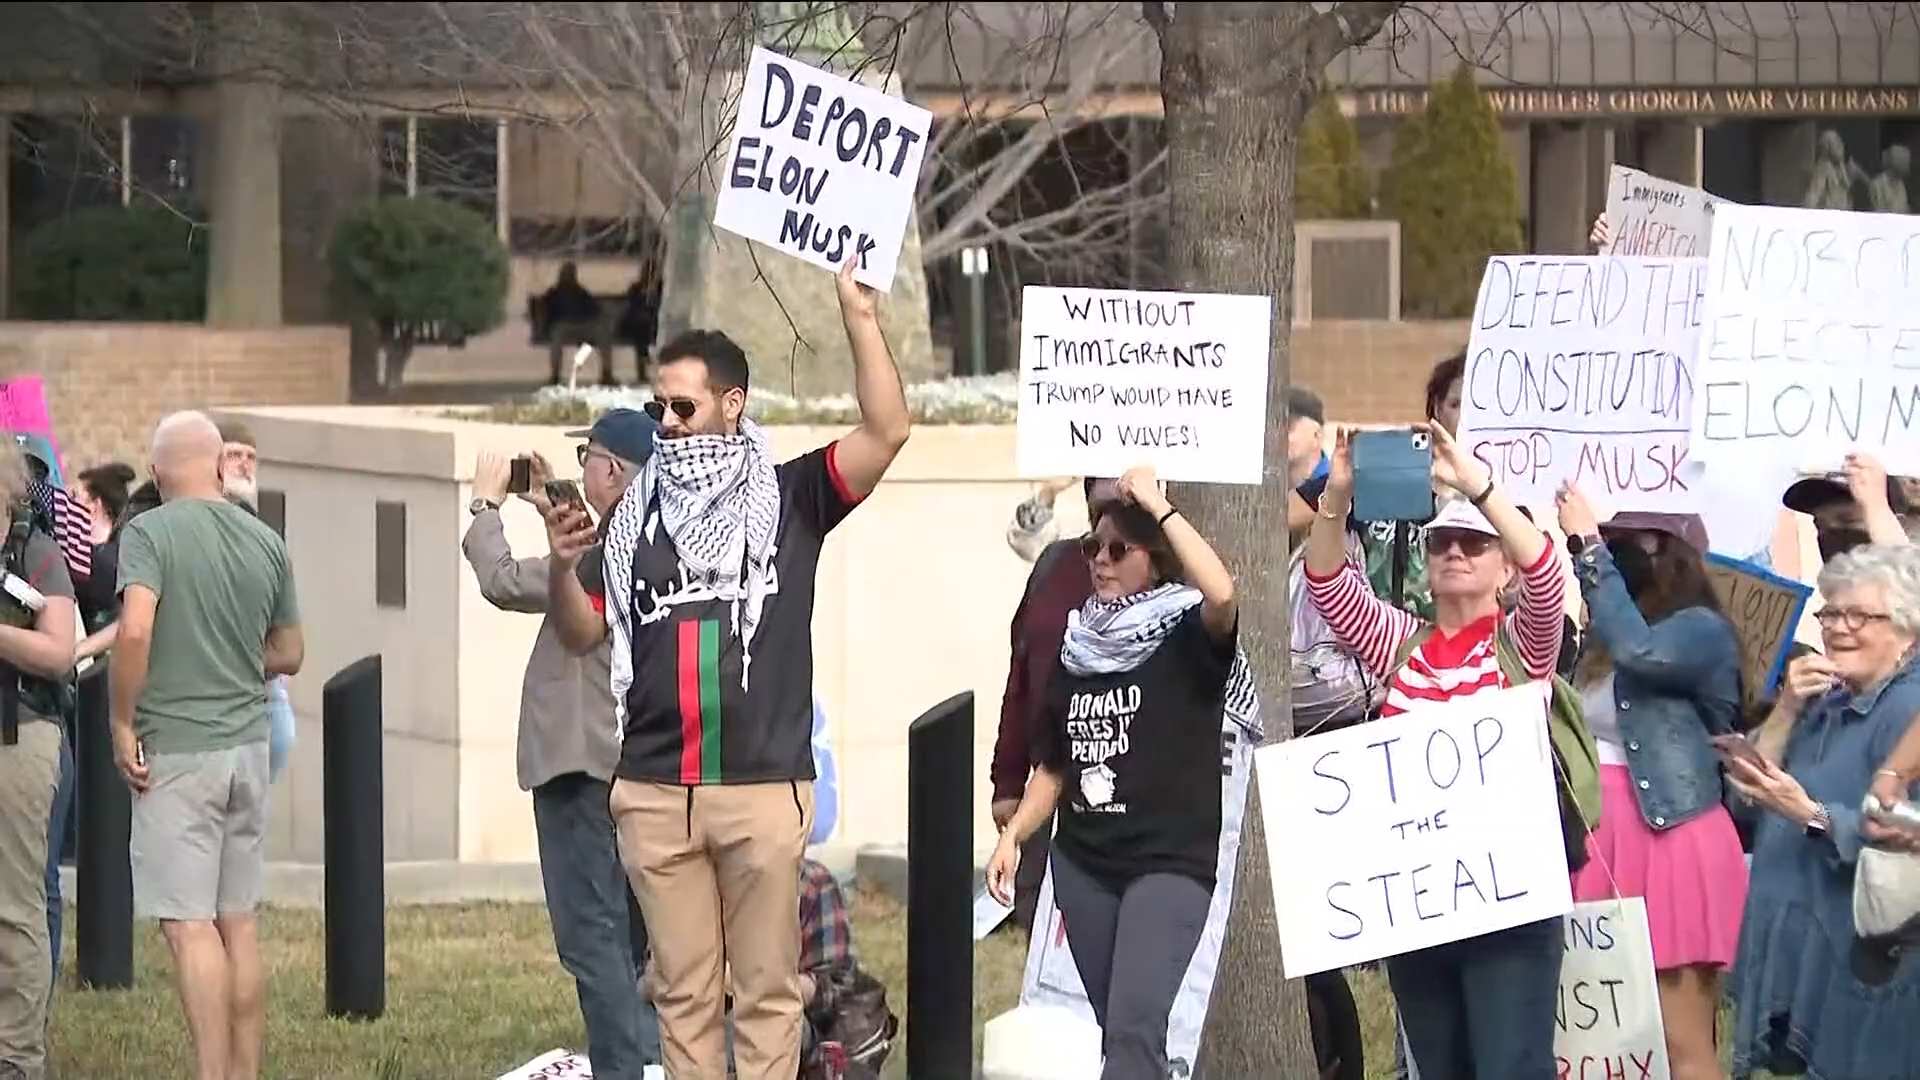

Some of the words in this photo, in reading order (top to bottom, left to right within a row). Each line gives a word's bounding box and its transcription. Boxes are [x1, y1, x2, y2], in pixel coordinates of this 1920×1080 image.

[760, 63, 920, 178] DEPORT
[1726, 89, 1774, 112] WAR
[1784, 89, 1908, 112] VETERANS
[731, 136, 829, 205] ELON
[779, 209, 876, 270] MUSK
[1062, 294, 1195, 327] WITHOUT
[1481, 257, 1629, 330] DEFEND
[1643, 263, 1705, 336] THE
[1032, 335, 1226, 370] IMMIGRANTS
[1029, 381, 1105, 405] TRUMP
[1178, 388, 1233, 408] HAVE
[1704, 377, 1863, 441] ELON
[1070, 420, 1102, 447] NO
[1117, 425, 1200, 448] WIVES!
[1473, 432, 1552, 485] STOP
[1575, 443, 1690, 495] MUSK
[1067, 684, 1142, 720] DONALD
[1312, 717, 1503, 815] STOP
[1391, 809, 1448, 839] THE
[1326, 852, 1528, 940] STEAL
[1564, 914, 1615, 952] NS
